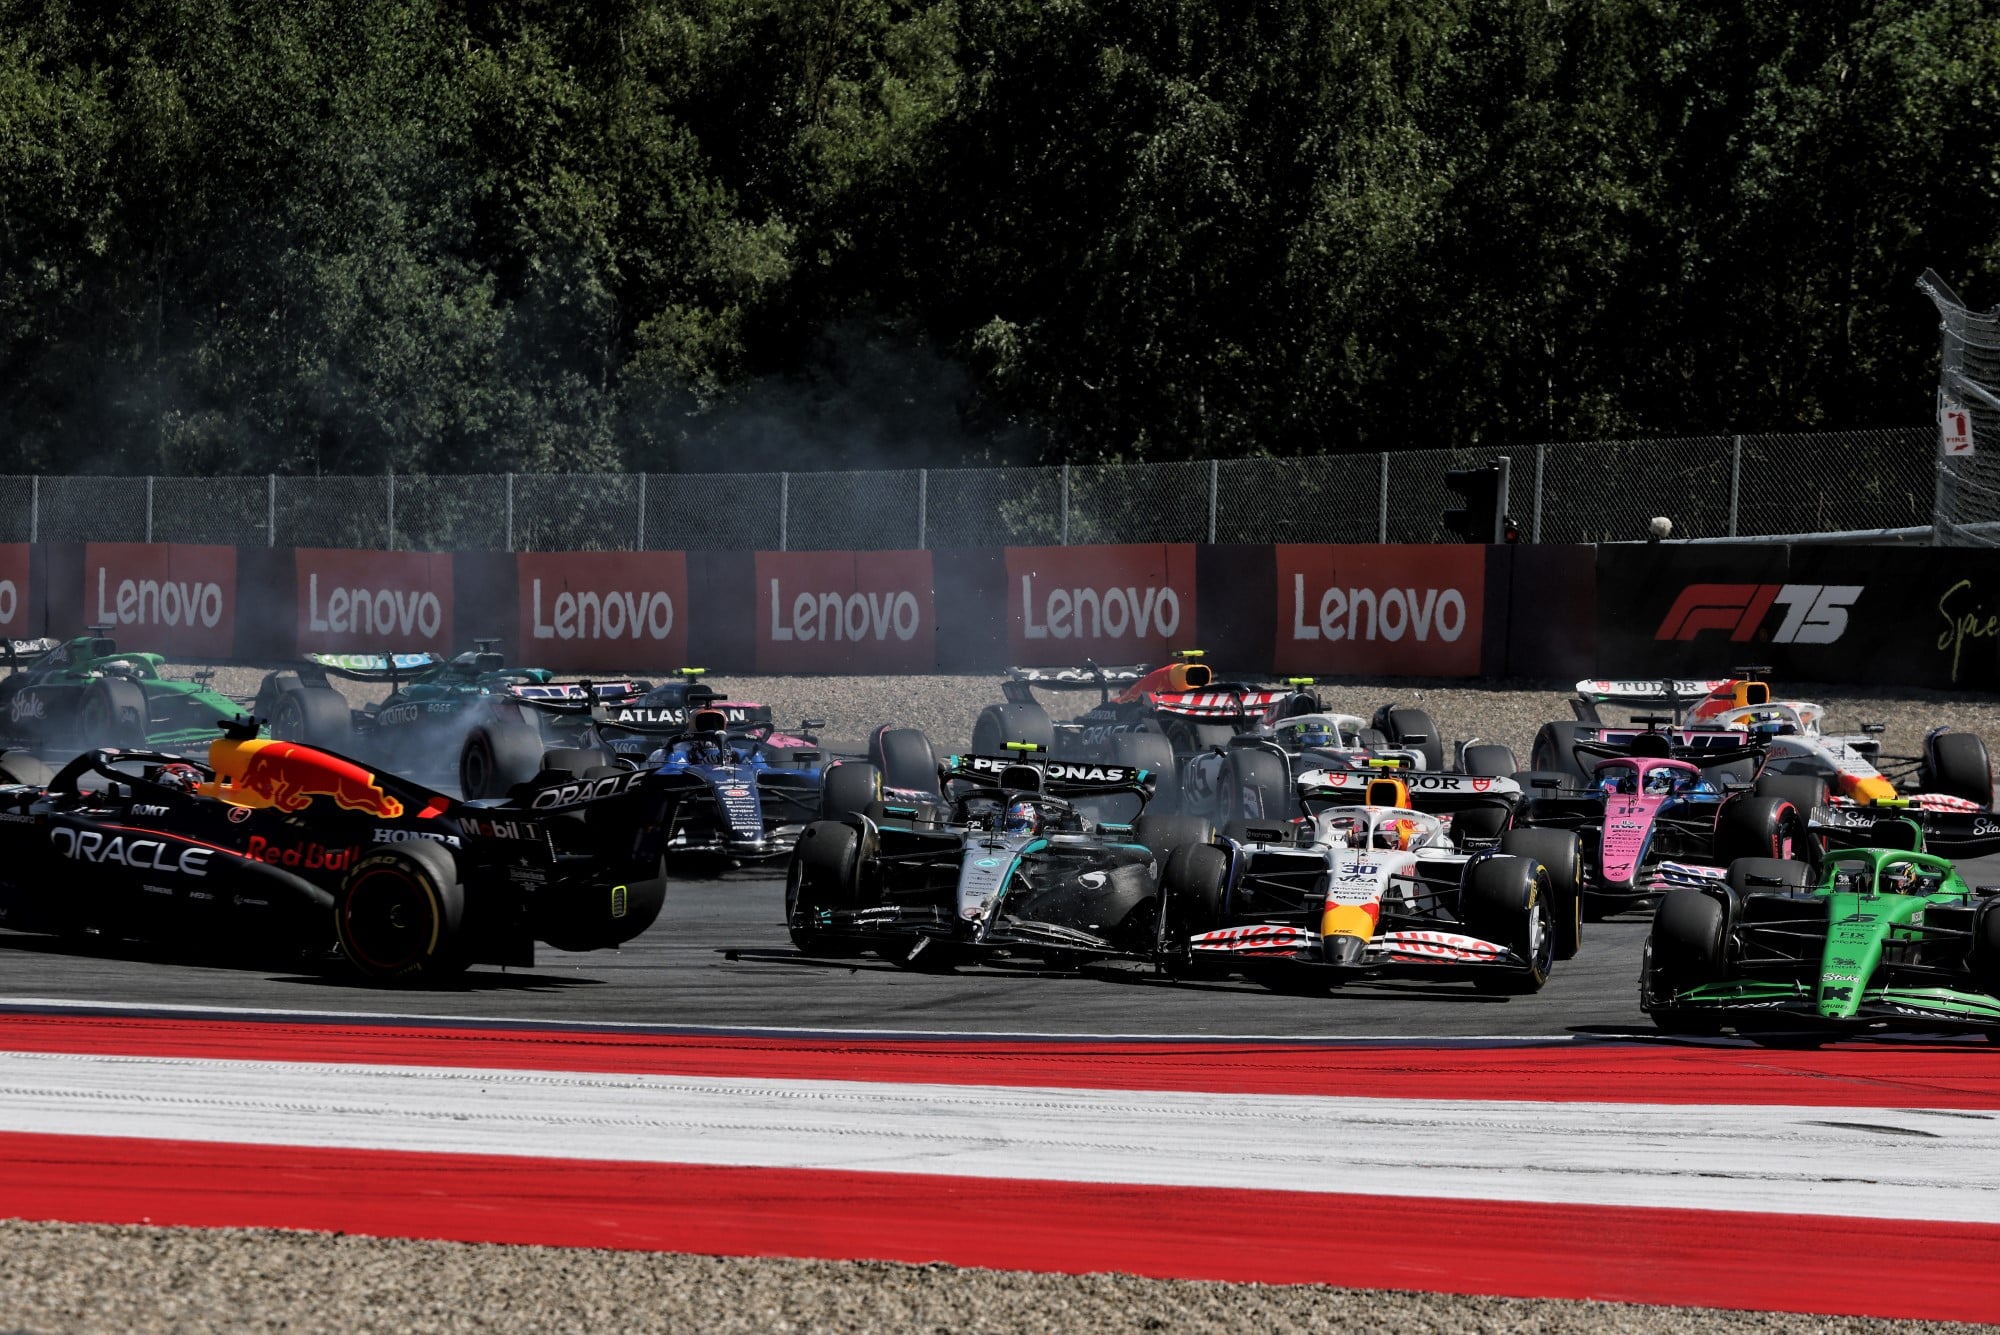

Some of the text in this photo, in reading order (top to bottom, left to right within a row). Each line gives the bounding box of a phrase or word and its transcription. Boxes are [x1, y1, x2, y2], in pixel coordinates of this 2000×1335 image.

[99, 567, 222, 627] Lenovo
[309, 574, 441, 637] Lenovo
[533, 579, 673, 639] Lenovo
[770, 578, 920, 641] Lenovo
[1022, 574, 1179, 639] Lenovo
[1293, 574, 1466, 642] Lenovo
[11, 692, 47, 722] Stake
[973, 758, 1124, 782] PEONAS
[130, 803, 170, 817] ROKT
[459, 817, 520, 840] Mobil
[1845, 811, 1880, 828] Stak
[50, 826, 215, 877] ORACLE
[247, 834, 361, 872] Red Bull
[1341, 864, 1378, 875] 30
[1336, 875, 1379, 884] VISA
